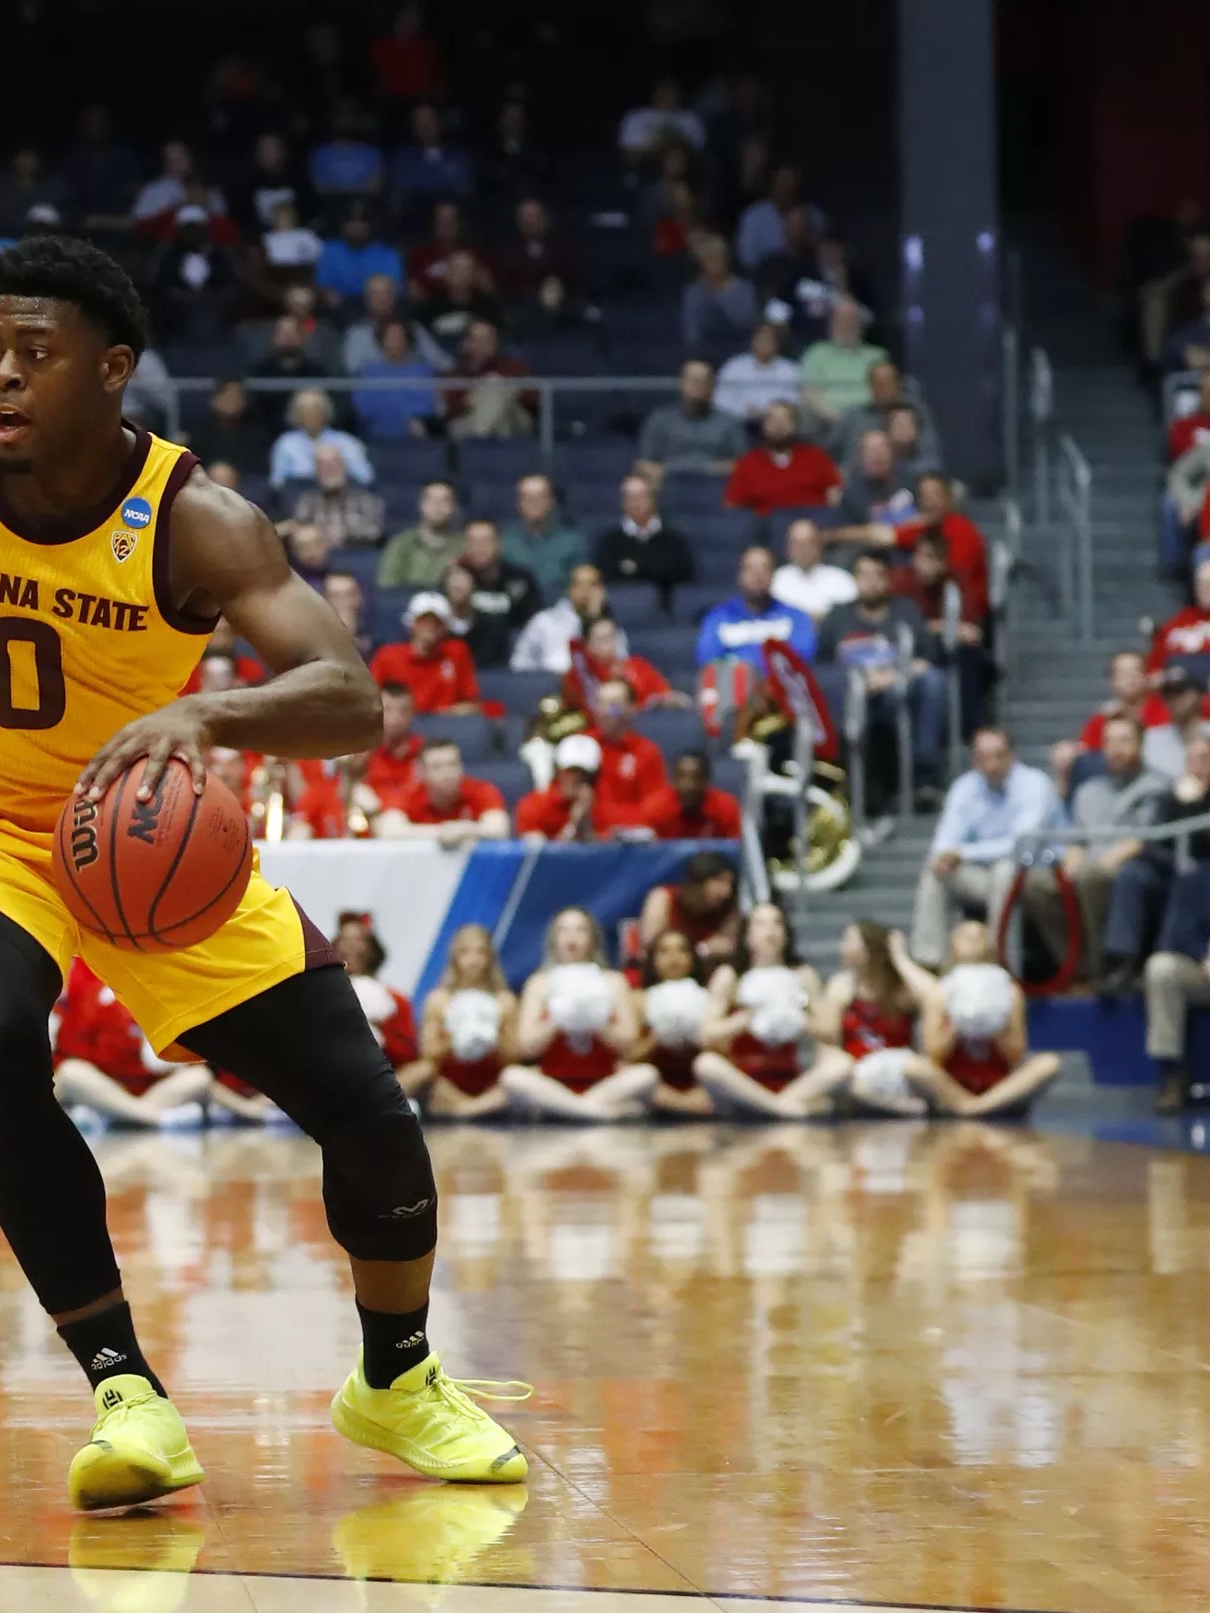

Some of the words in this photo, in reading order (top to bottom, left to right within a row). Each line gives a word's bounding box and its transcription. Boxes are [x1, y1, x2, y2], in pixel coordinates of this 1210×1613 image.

[123, 508, 150, 523] NCAA
[116, 545, 128, 557] 12
[51, 588, 150, 632] STATE
[91, 1353, 127, 1371] adidas
